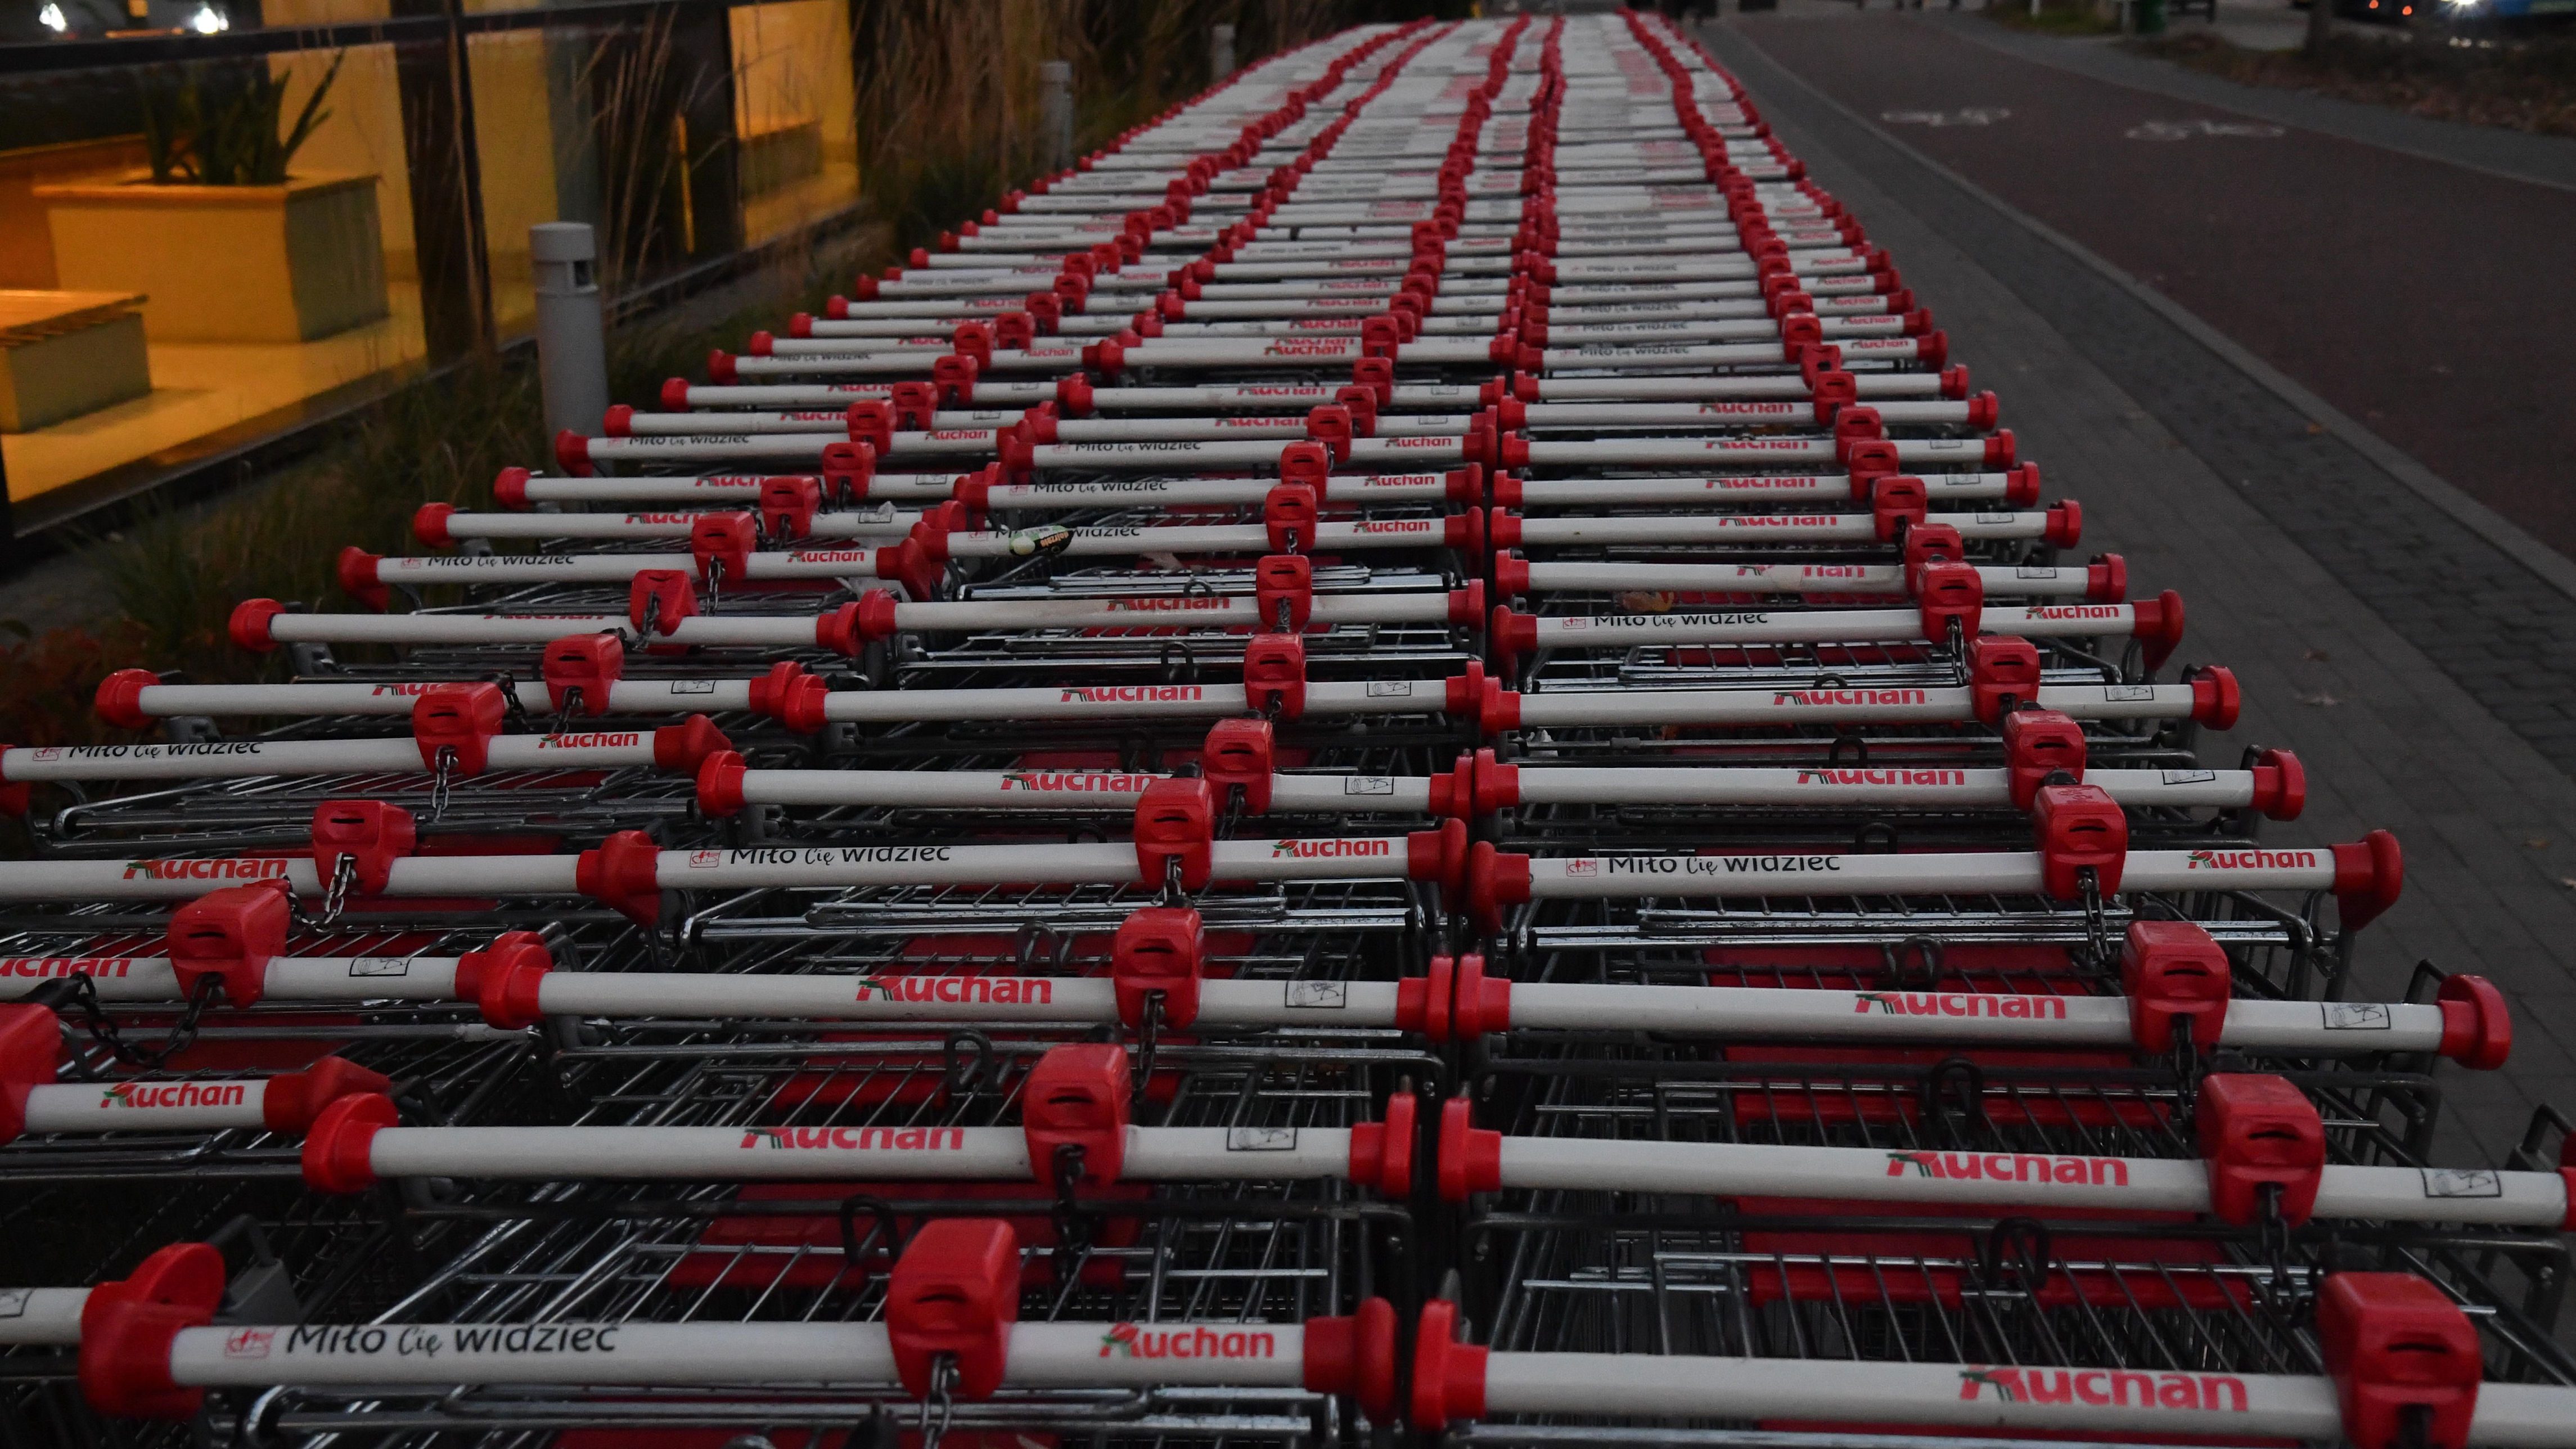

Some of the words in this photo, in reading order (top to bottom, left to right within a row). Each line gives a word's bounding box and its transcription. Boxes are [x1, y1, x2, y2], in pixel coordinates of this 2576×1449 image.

[1265, 345, 1346, 355] Auchan
[926, 430, 988, 440] Auchan
[1385, 437, 1452, 447] Auchan
[1364, 476, 1435, 487] Auchan
[1353, 521, 1430, 533] Auchan
[787, 550, 864, 562] Auchan
[1107, 597, 1230, 611] Auchan
[2026, 605, 2119, 618] Auchan
[1061, 686, 1201, 702] Auchan
[1773, 688, 1925, 705] Auchan
[538, 733, 639, 748] Auchan
[1798, 770, 1963, 786] Auchan
[1273, 838, 1389, 857] Auchan
[2188, 849, 2316, 868] Auchan
[123, 859, 287, 879] Auchan
[857, 975, 1051, 1005] Auchan
[1854, 991, 2065, 1019] Auchan
[101, 1082, 244, 1108] Auchan
[741, 1126, 963, 1149] Auchan
[1887, 1149, 2128, 1186] Auchan
[1101, 1323, 1274, 1359] Auchan
[1960, 1363, 2249, 1412] Auchan
